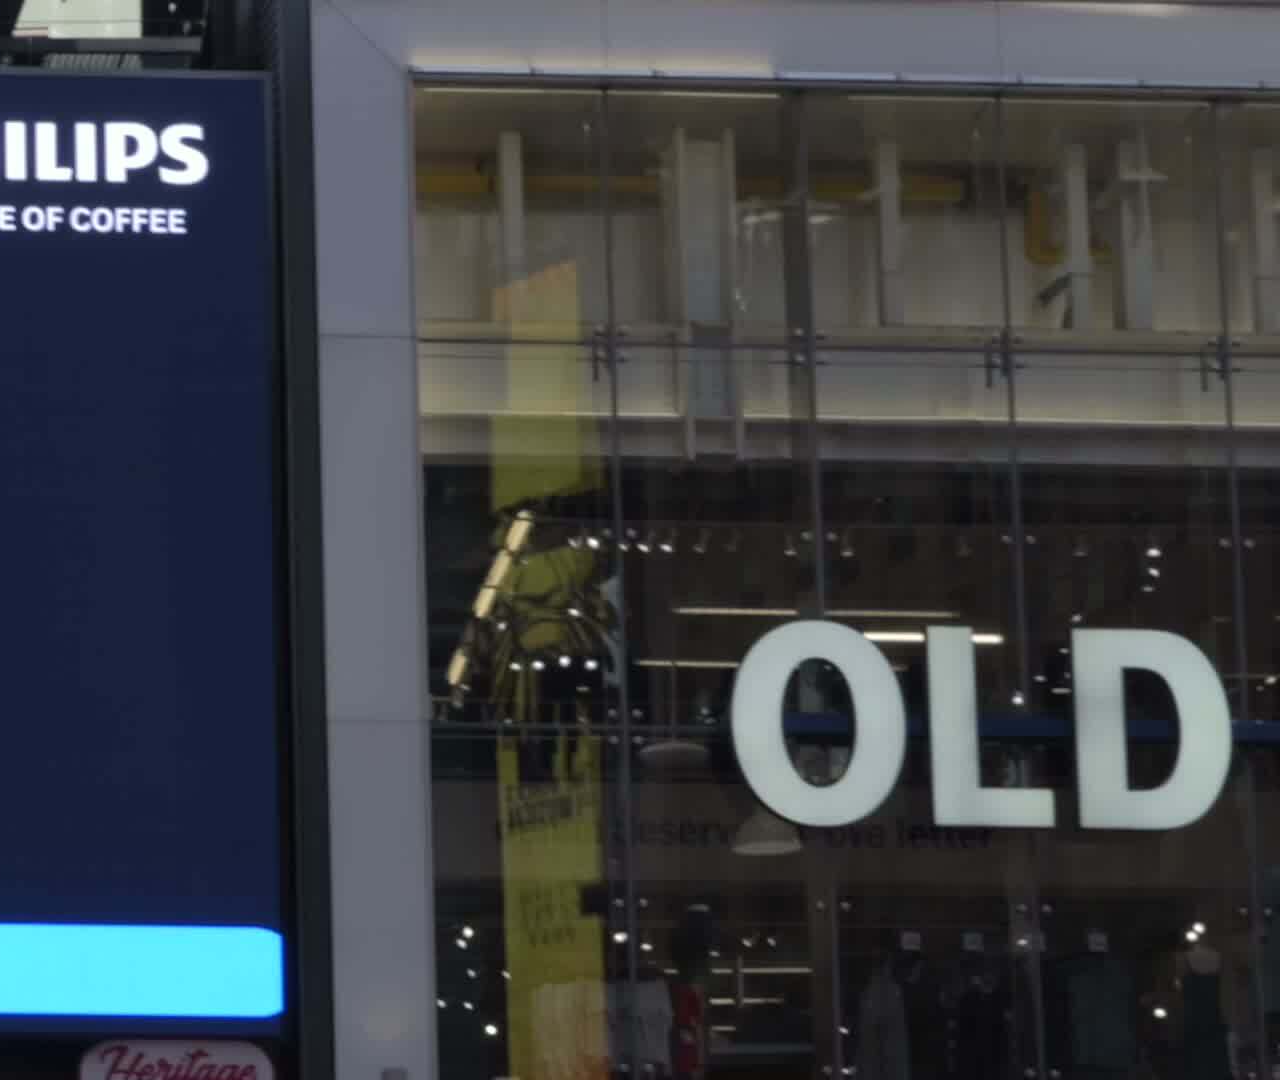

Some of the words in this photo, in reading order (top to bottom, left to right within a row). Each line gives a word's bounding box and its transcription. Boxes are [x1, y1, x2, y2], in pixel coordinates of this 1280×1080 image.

[21, 205, 65, 232] OF
[69, 206, 188, 235] COFFEE
[732, 620, 1233, 830] OLD
